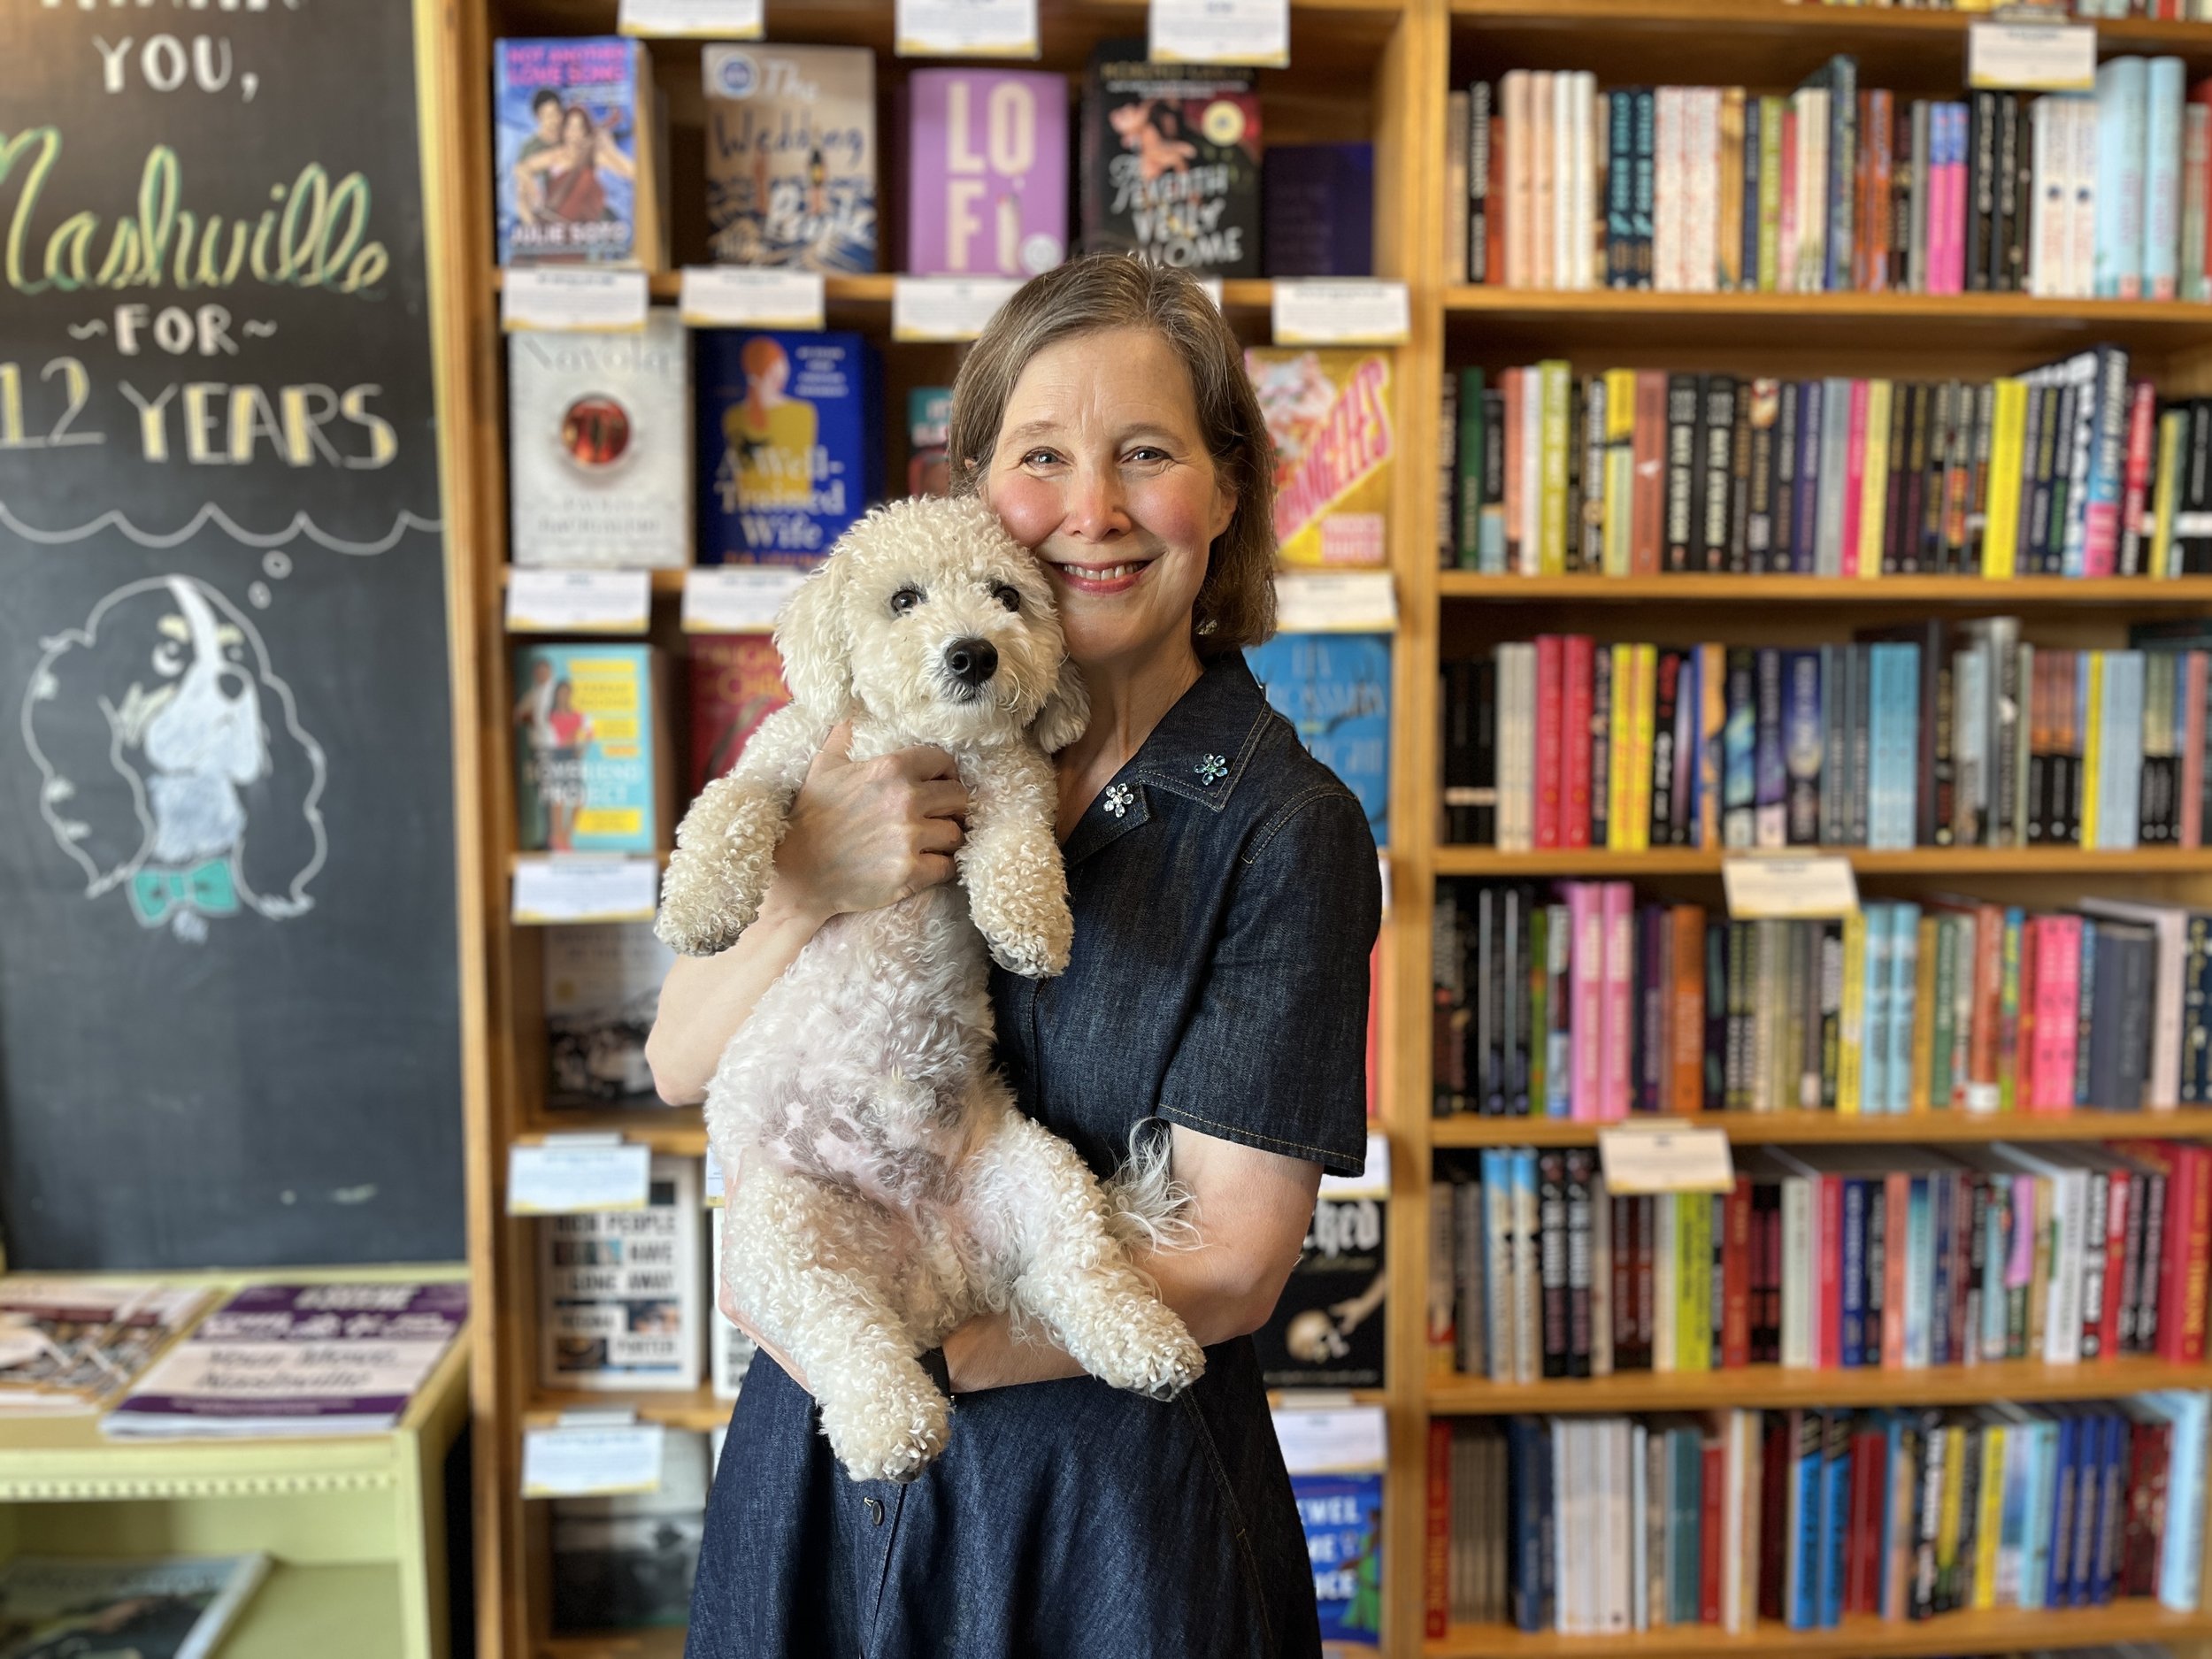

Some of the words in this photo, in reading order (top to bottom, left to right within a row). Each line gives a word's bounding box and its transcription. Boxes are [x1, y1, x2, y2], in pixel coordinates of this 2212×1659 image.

[92, 34, 259, 103] YOU,
[945, 80, 1037, 176] LO
[0, 124, 389, 301] Nashville
[0, 357, 106, 449] 12
[118, 380, 398, 469] YEARS
